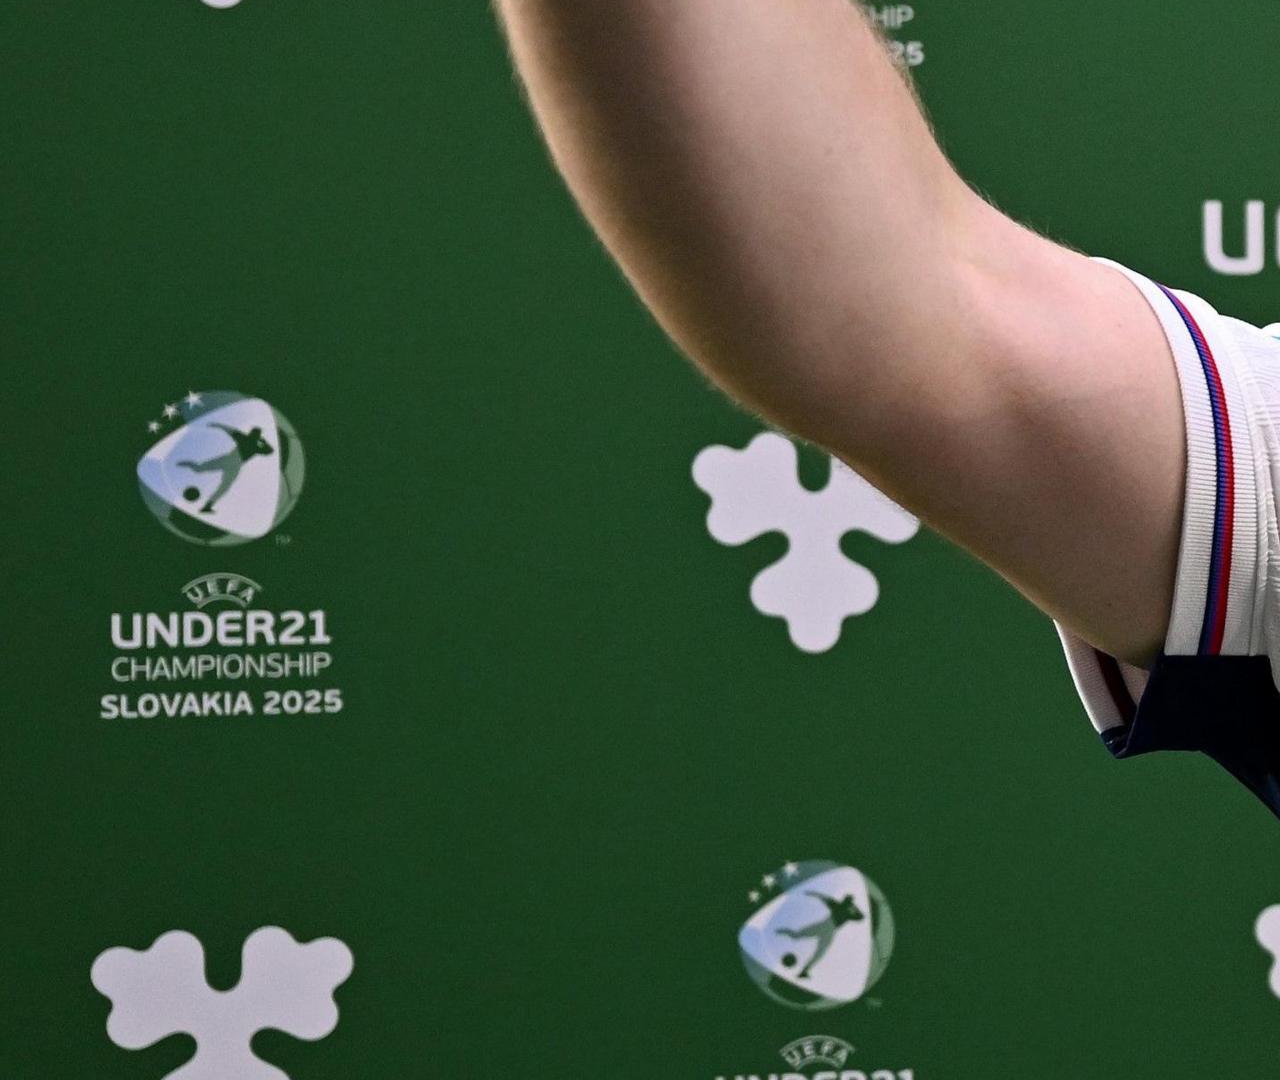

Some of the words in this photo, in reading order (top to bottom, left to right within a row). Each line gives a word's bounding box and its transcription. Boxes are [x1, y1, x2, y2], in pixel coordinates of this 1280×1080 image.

[182, 573, 262, 608] UEFA
[111, 610, 332, 649] UNDER21
[111, 652, 332, 681] CHAMPIONSHIP
[100, 691, 254, 719] SLOVAKIA
[263, 689, 343, 715] 2025
